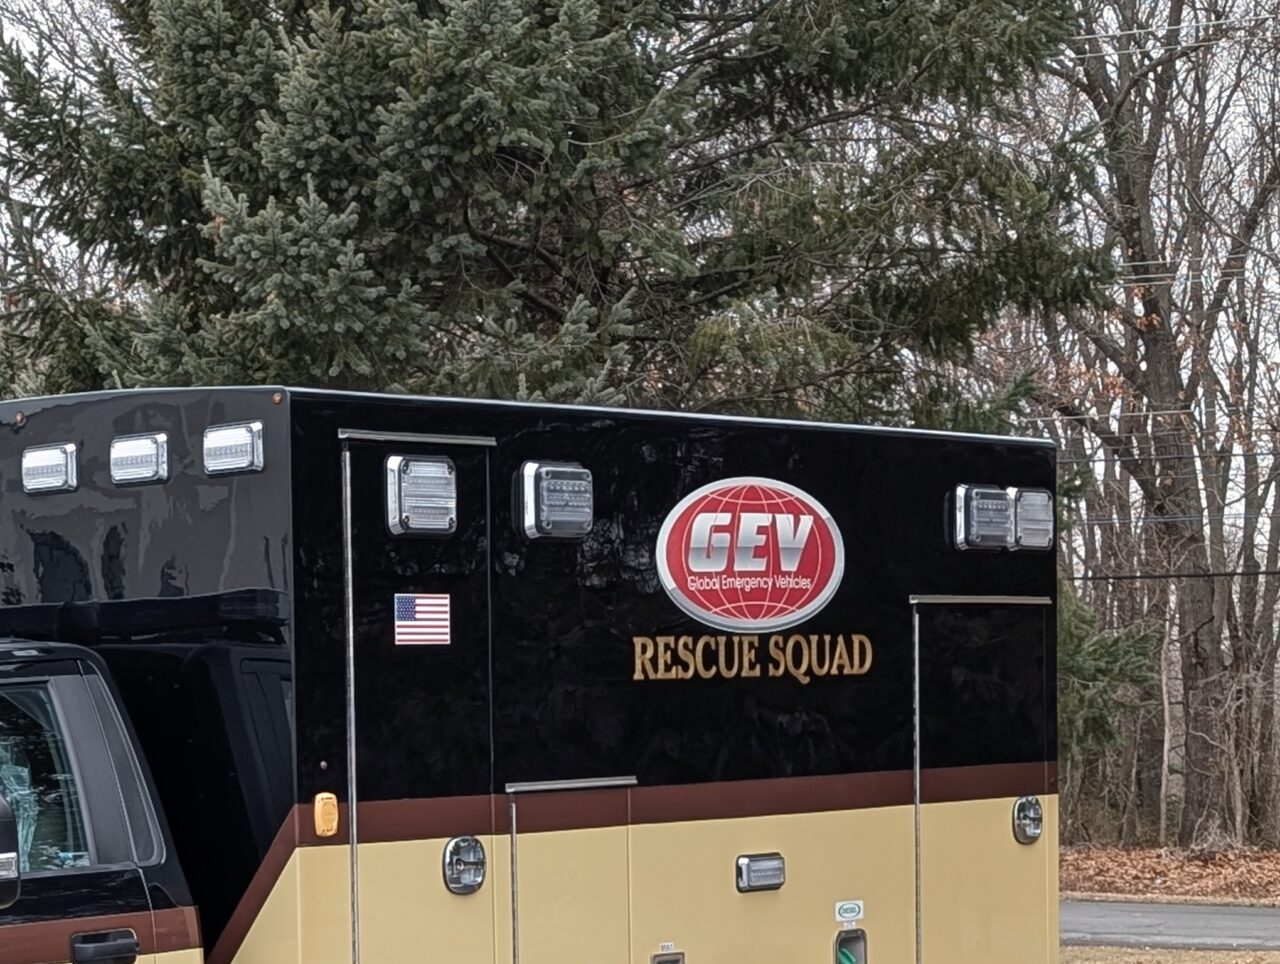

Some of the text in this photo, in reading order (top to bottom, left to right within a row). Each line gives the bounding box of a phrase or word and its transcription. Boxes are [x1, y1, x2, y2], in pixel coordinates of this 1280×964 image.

[687, 512, 813, 572] GEV
[688, 574, 812, 592] Global Emergency Vehicles
[632, 634, 873, 685] RESCUE SQUAD
